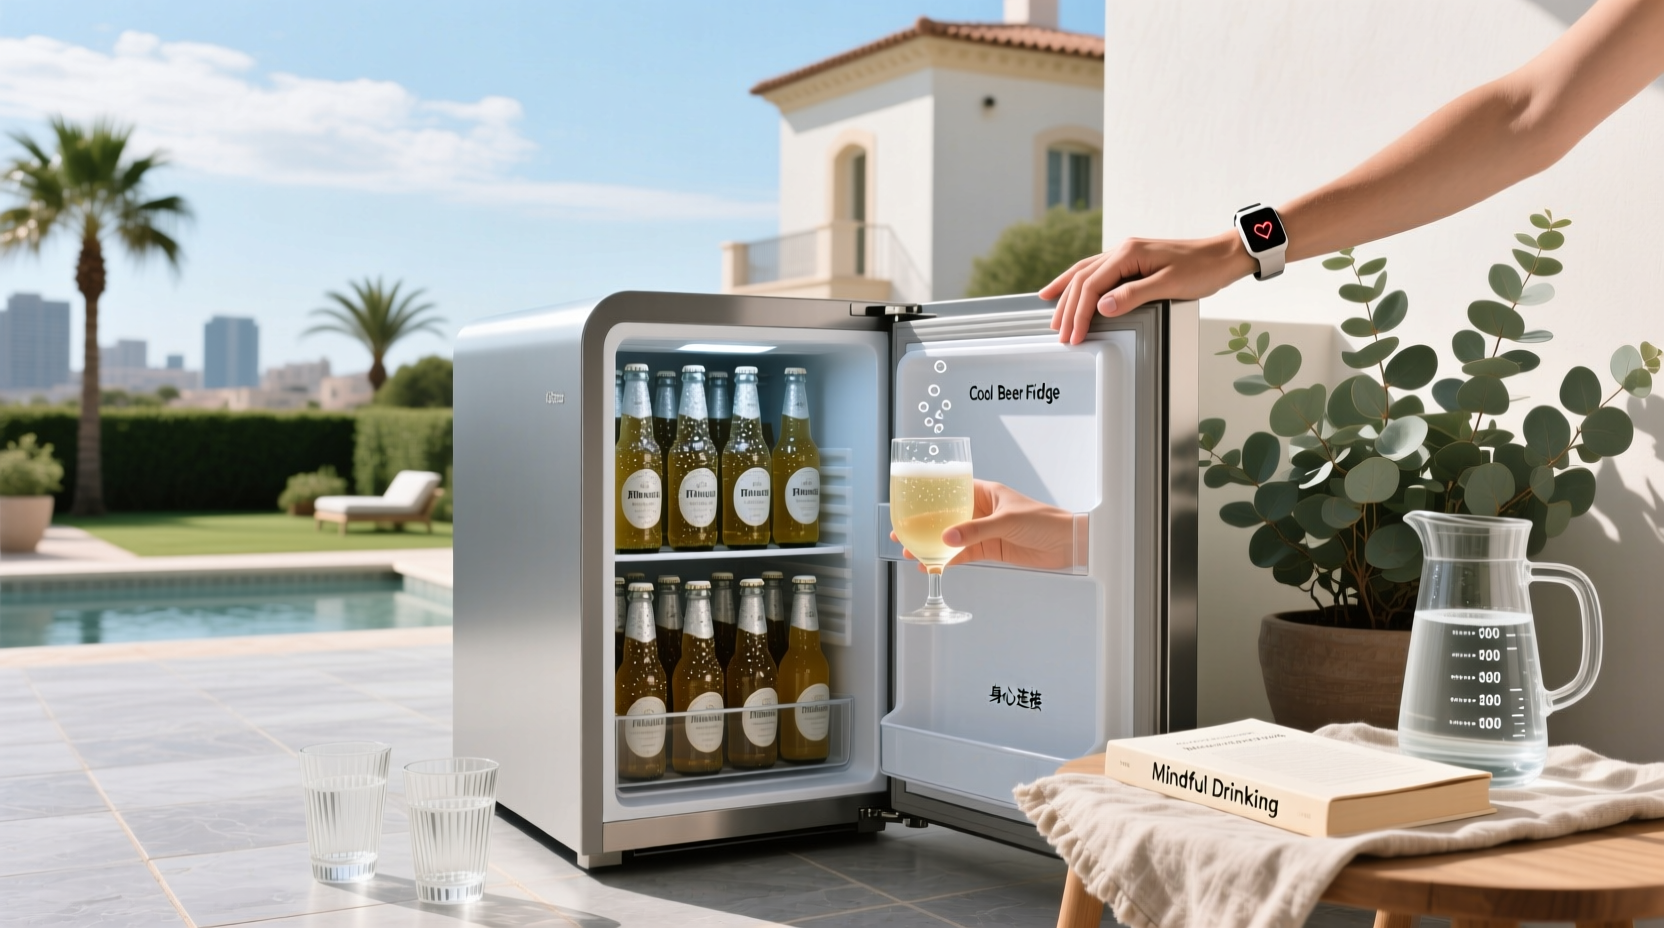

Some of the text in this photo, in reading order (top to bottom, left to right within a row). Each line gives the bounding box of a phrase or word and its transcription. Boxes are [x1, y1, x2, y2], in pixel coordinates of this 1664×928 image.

[969, 382, 1060, 404] Cool Beer Fidge
[1152, 761, 1279, 819] Mindful Drinking
